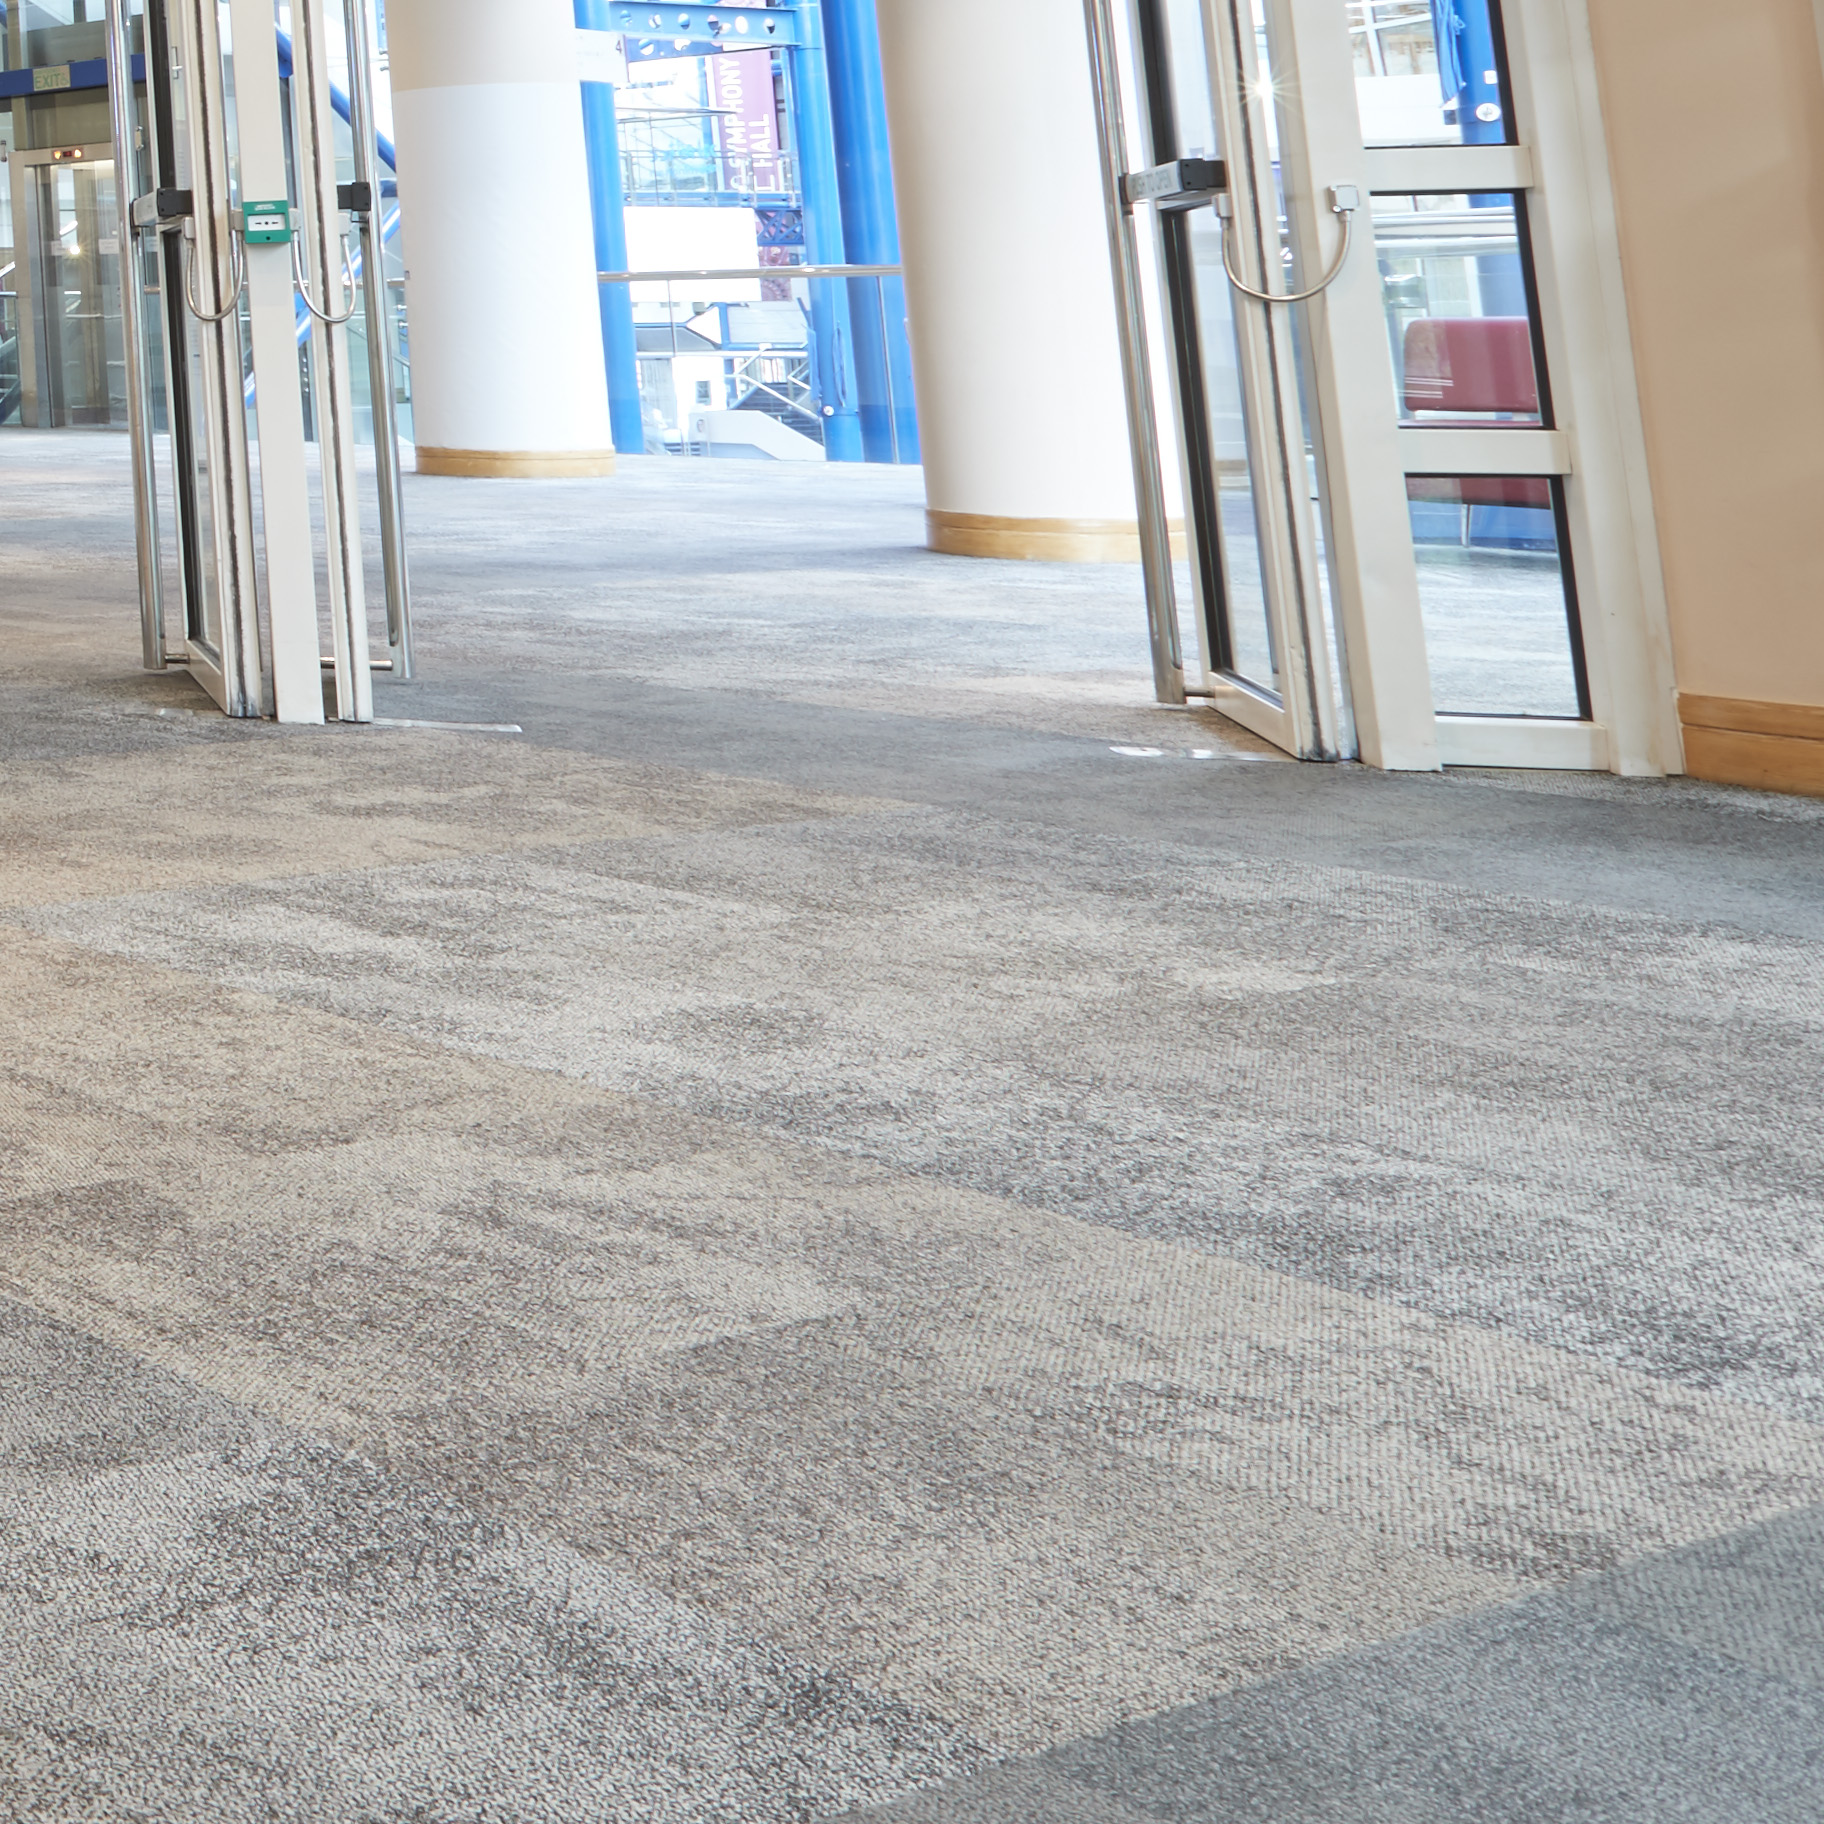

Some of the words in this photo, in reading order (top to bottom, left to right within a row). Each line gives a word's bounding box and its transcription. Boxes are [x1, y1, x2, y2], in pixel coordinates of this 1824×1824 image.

[35, 73, 61, 90] EXIT
[718, 57, 749, 169] SYMPHONY
[748, 113, 774, 168] HALL
